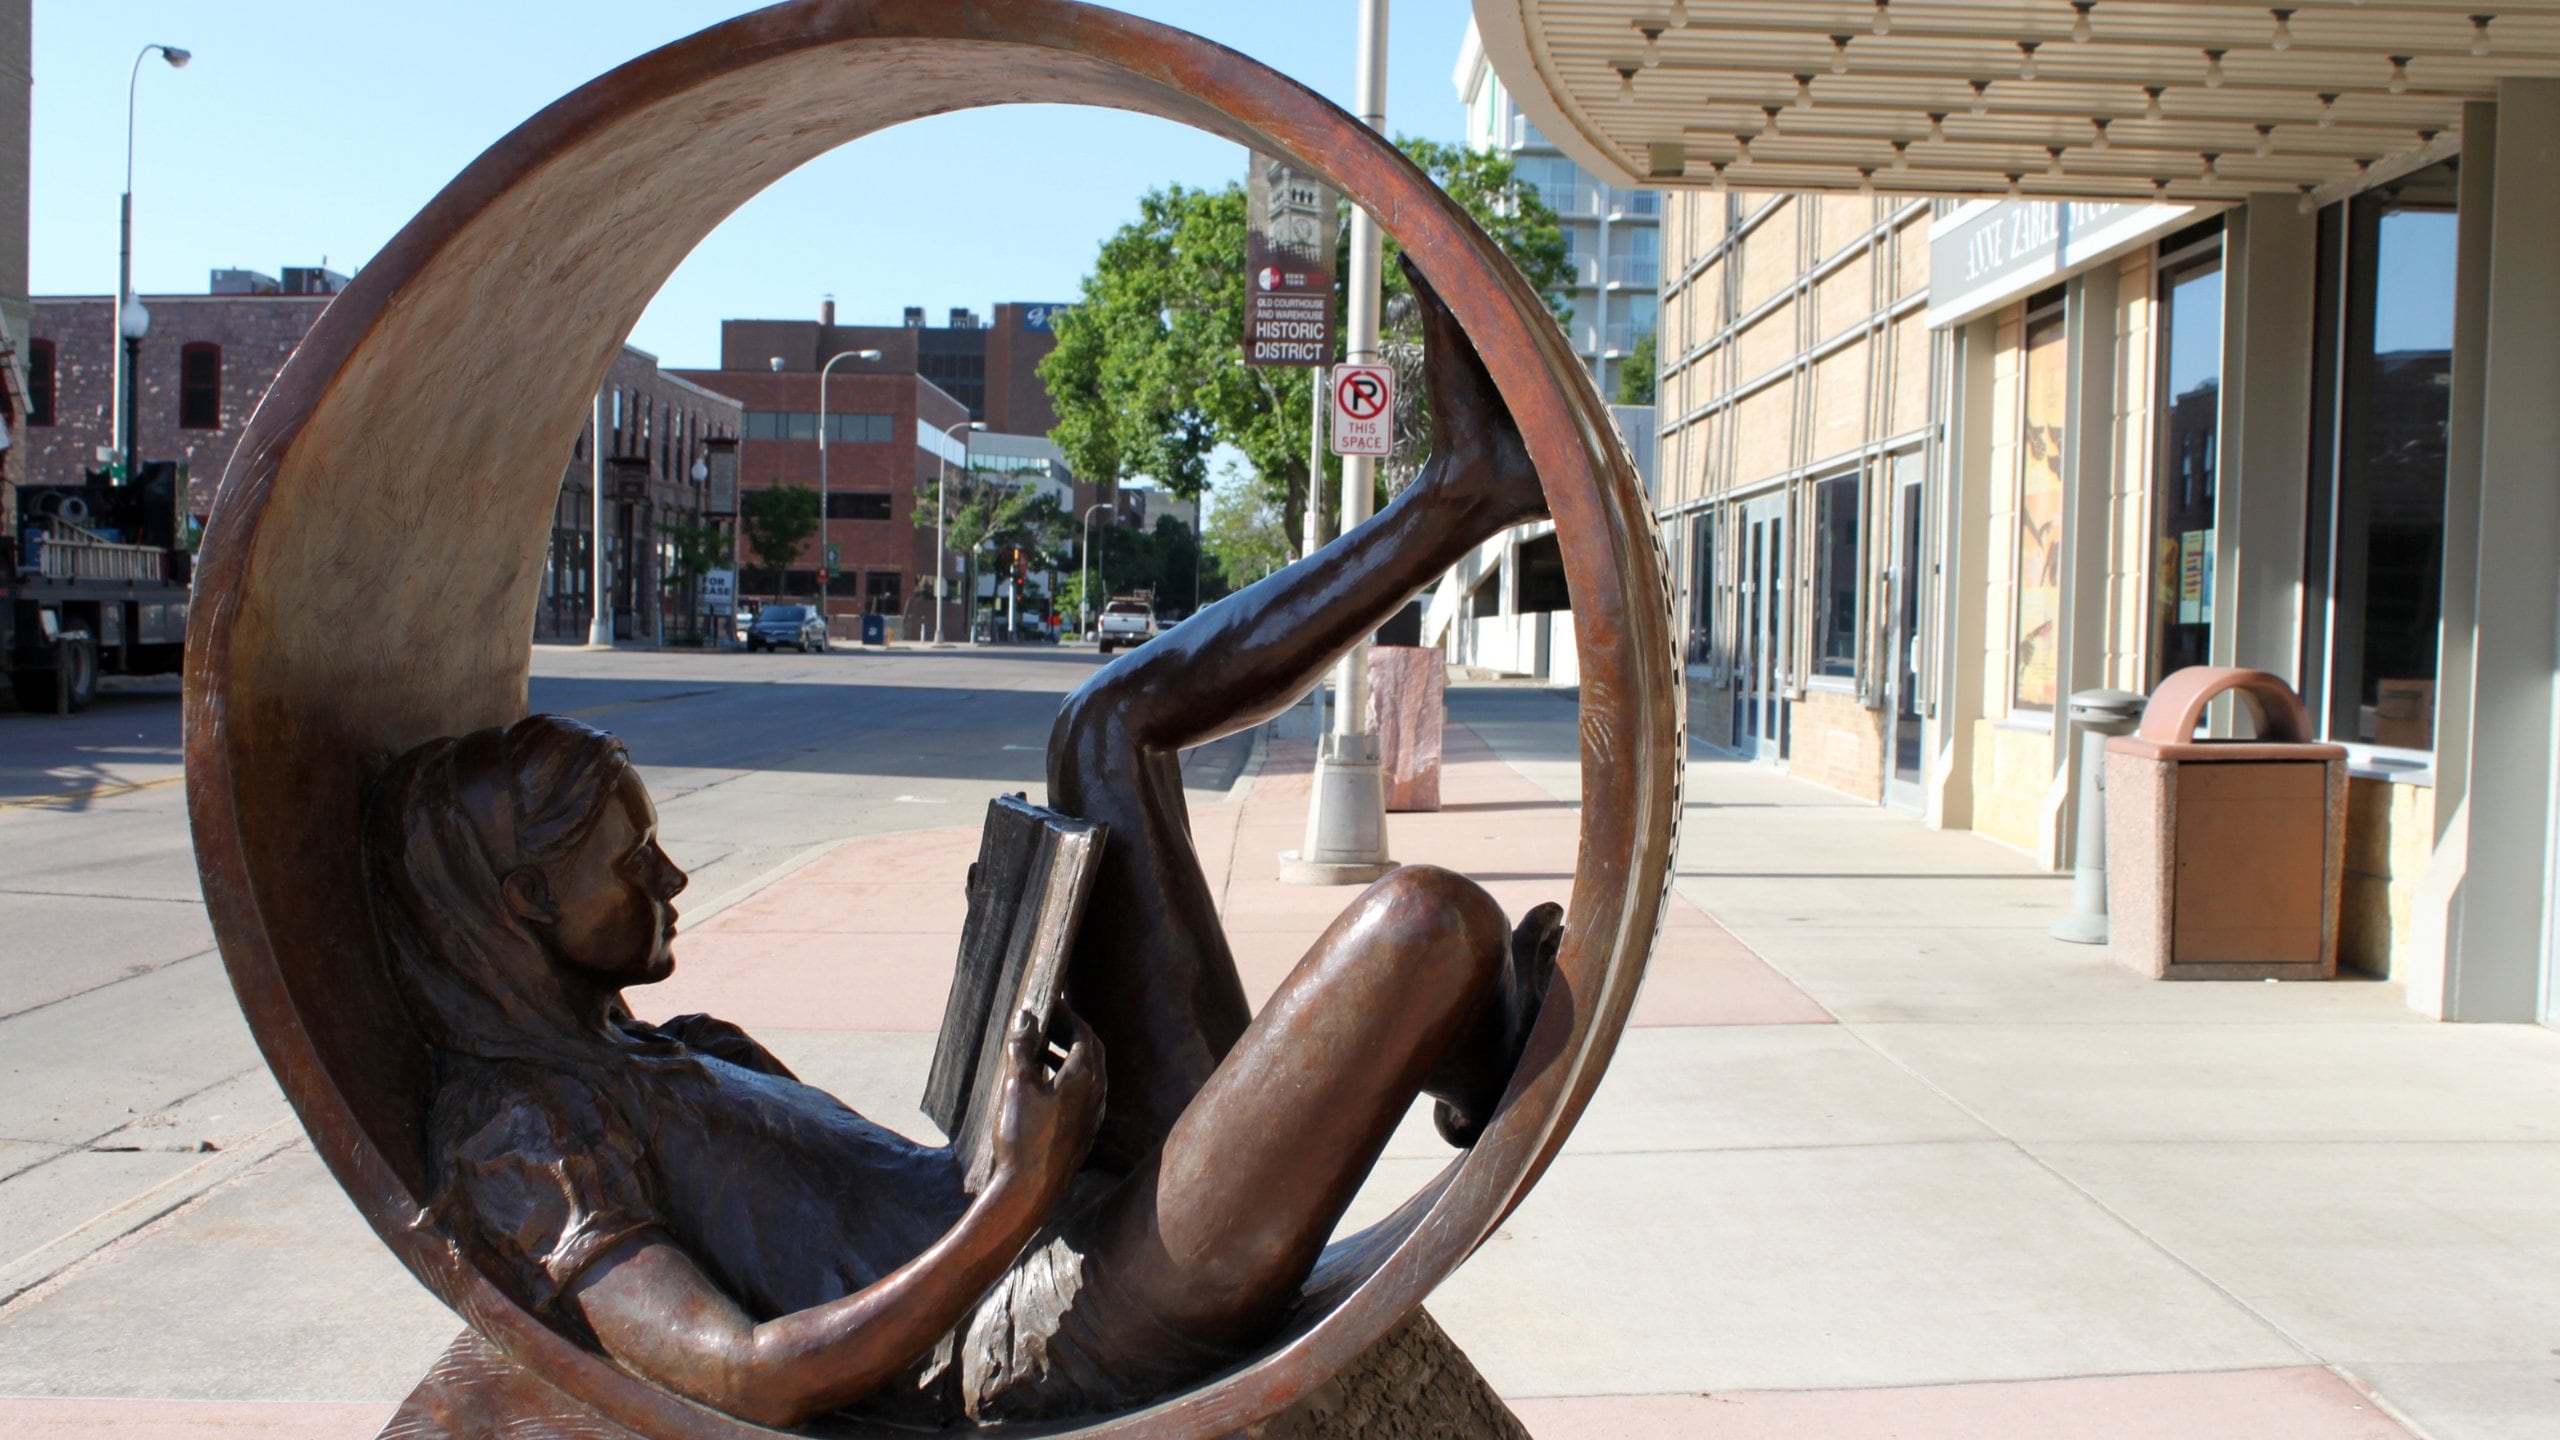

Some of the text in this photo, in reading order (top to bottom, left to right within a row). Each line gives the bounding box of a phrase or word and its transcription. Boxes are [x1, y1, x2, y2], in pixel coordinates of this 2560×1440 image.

[1966, 217, 2003, 281] ANNE
[1257, 298, 1324, 309] OLD COURTHOUSE
[1257, 310, 1324, 320] AND WAREHOUSE
[1256, 322, 1324, 339] HISTORIC
[1255, 342, 1324, 360] DISTRICT
[1349, 422, 1376, 434] THIS
[1342, 436, 1381, 448] SPACE
[702, 576, 725, 586] FOR
[701, 586, 731, 596] EASE
